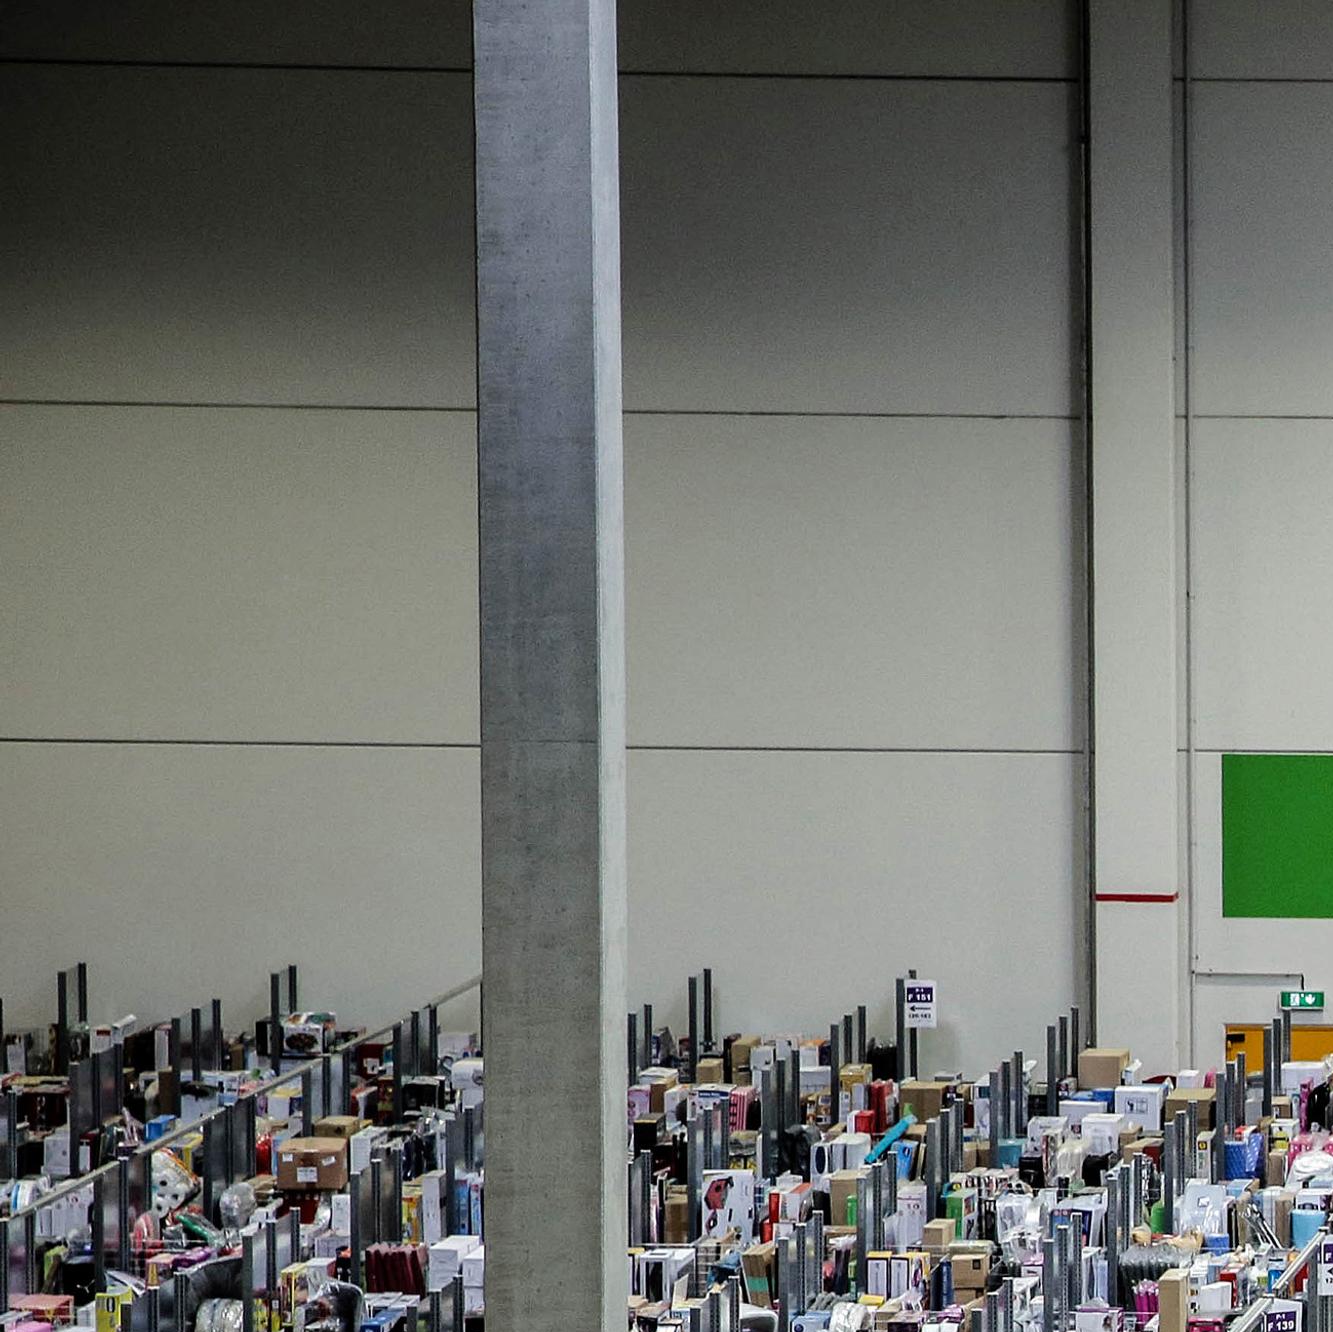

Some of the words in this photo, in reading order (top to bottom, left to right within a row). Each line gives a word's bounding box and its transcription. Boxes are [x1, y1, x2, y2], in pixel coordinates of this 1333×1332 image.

[916, 993, 931, 1001] 151
[1325, 1253, 1332, 1262] F
[1267, 1322, 1274, 1331] F
[1276, 1320, 1295, 1330] 139
